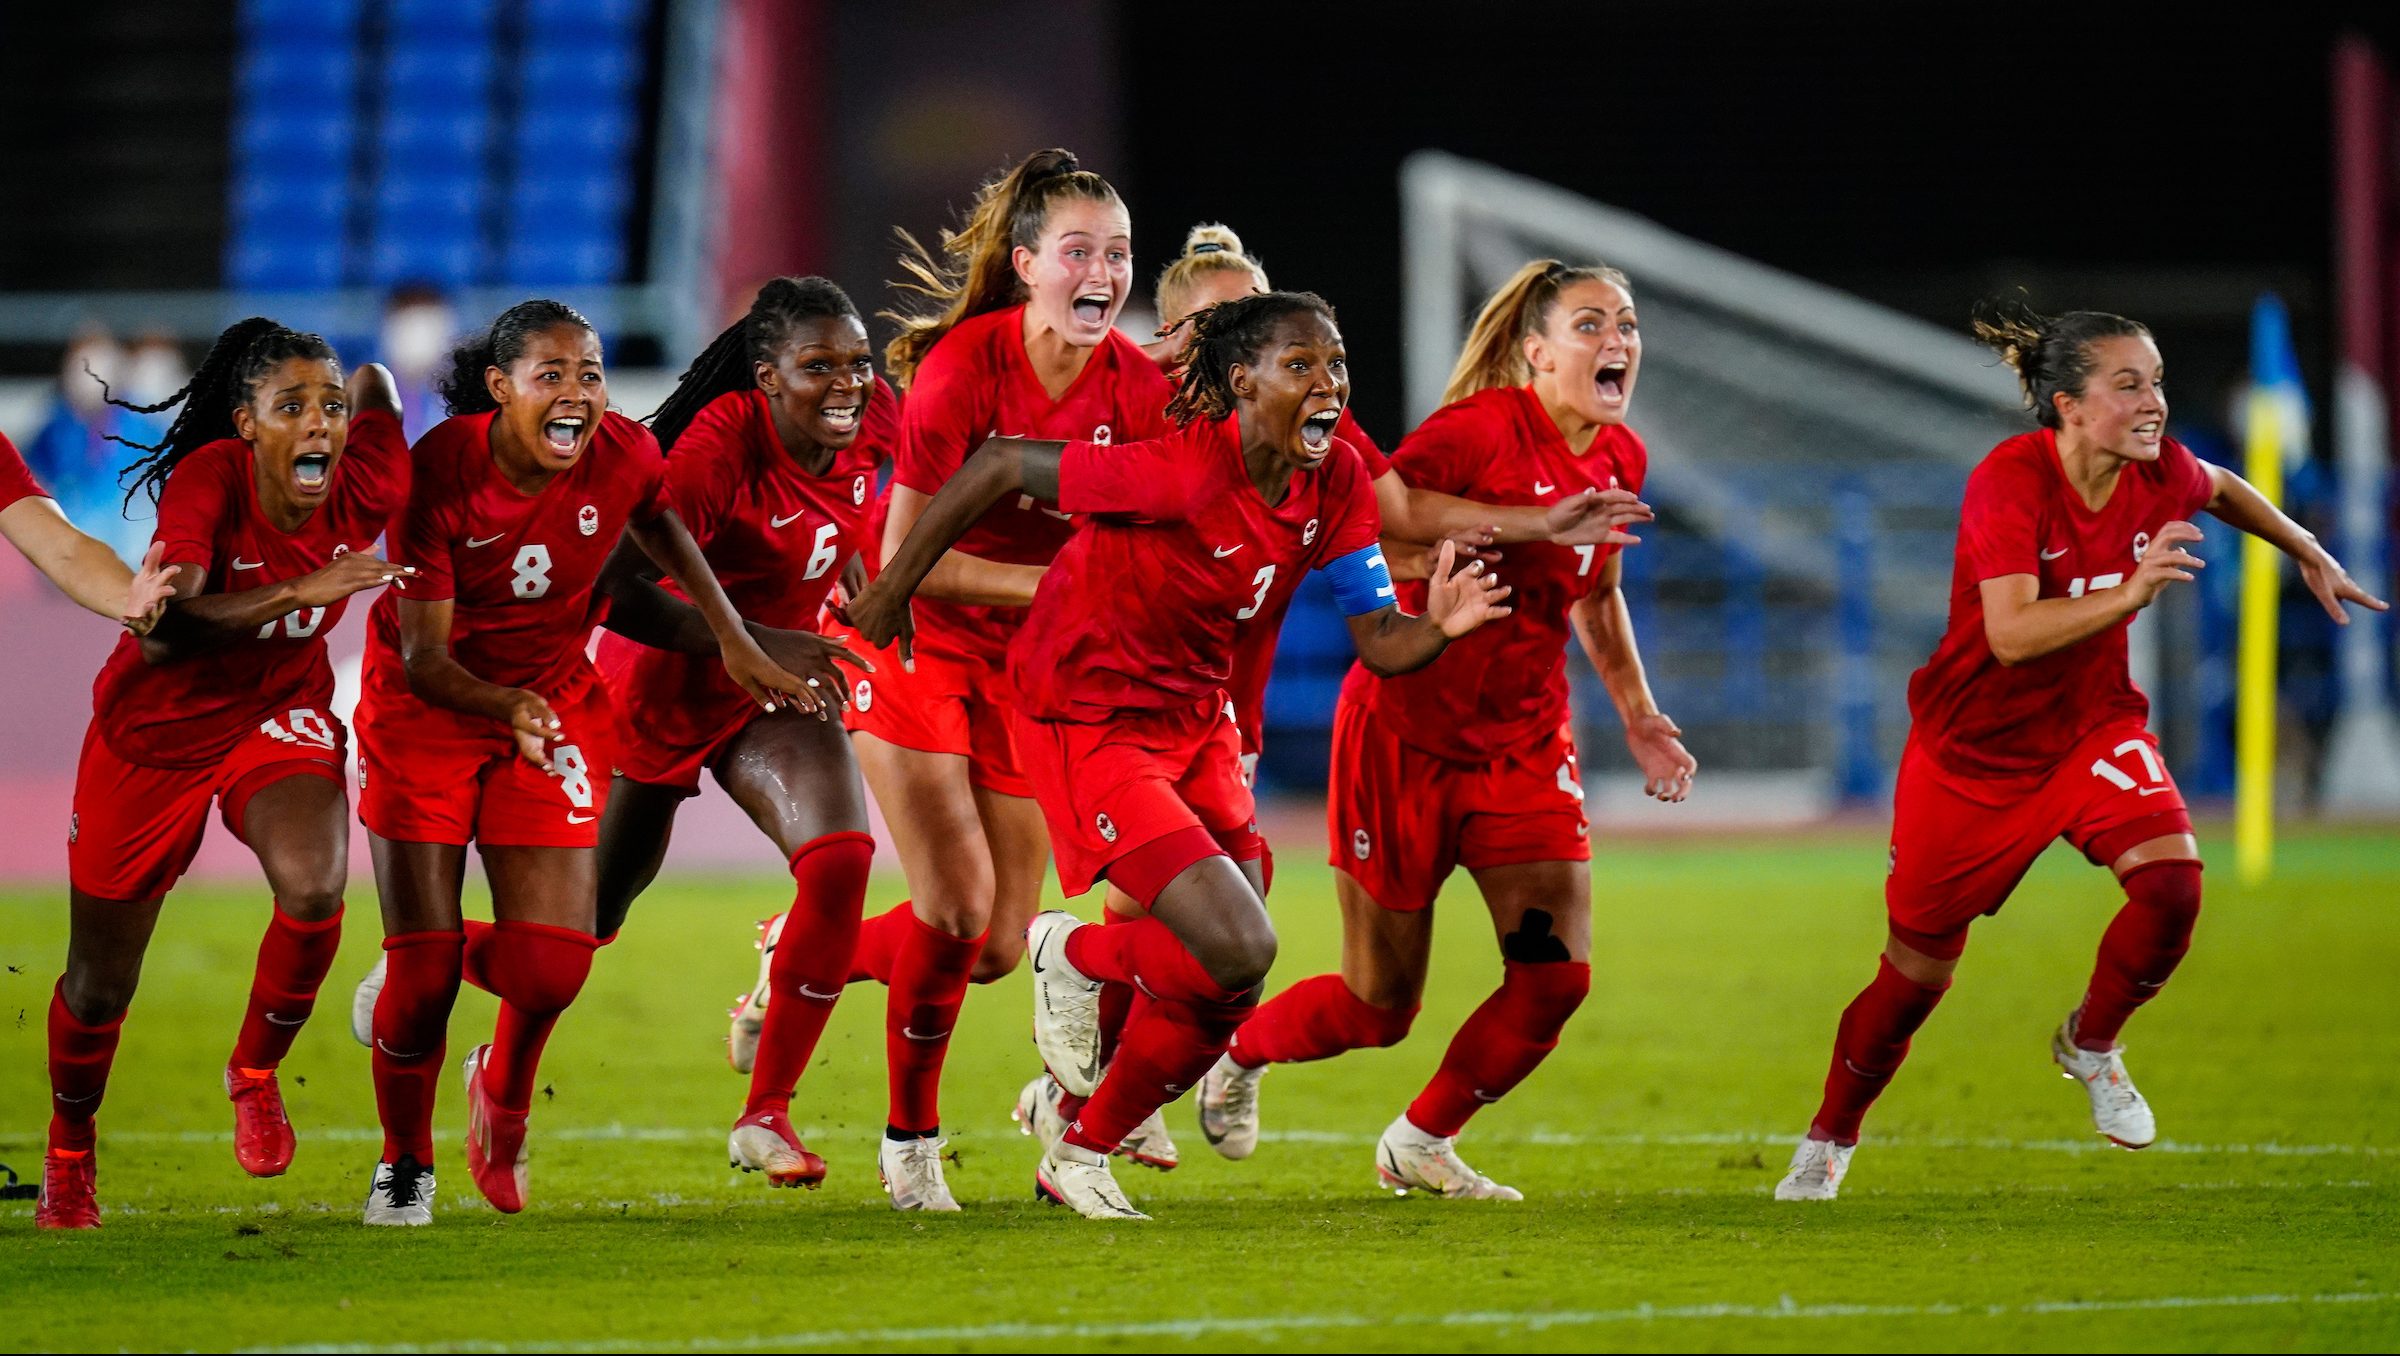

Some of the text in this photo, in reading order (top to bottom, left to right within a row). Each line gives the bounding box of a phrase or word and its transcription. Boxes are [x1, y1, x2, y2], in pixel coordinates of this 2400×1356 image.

[510, 544, 553, 598] 8
[802, 522, 839, 580] 6
[1236, 564, 1276, 620] 3
[260, 708, 336, 749] 10
[553, 745, 593, 807] 8
[2090, 739, 2164, 790] 17
